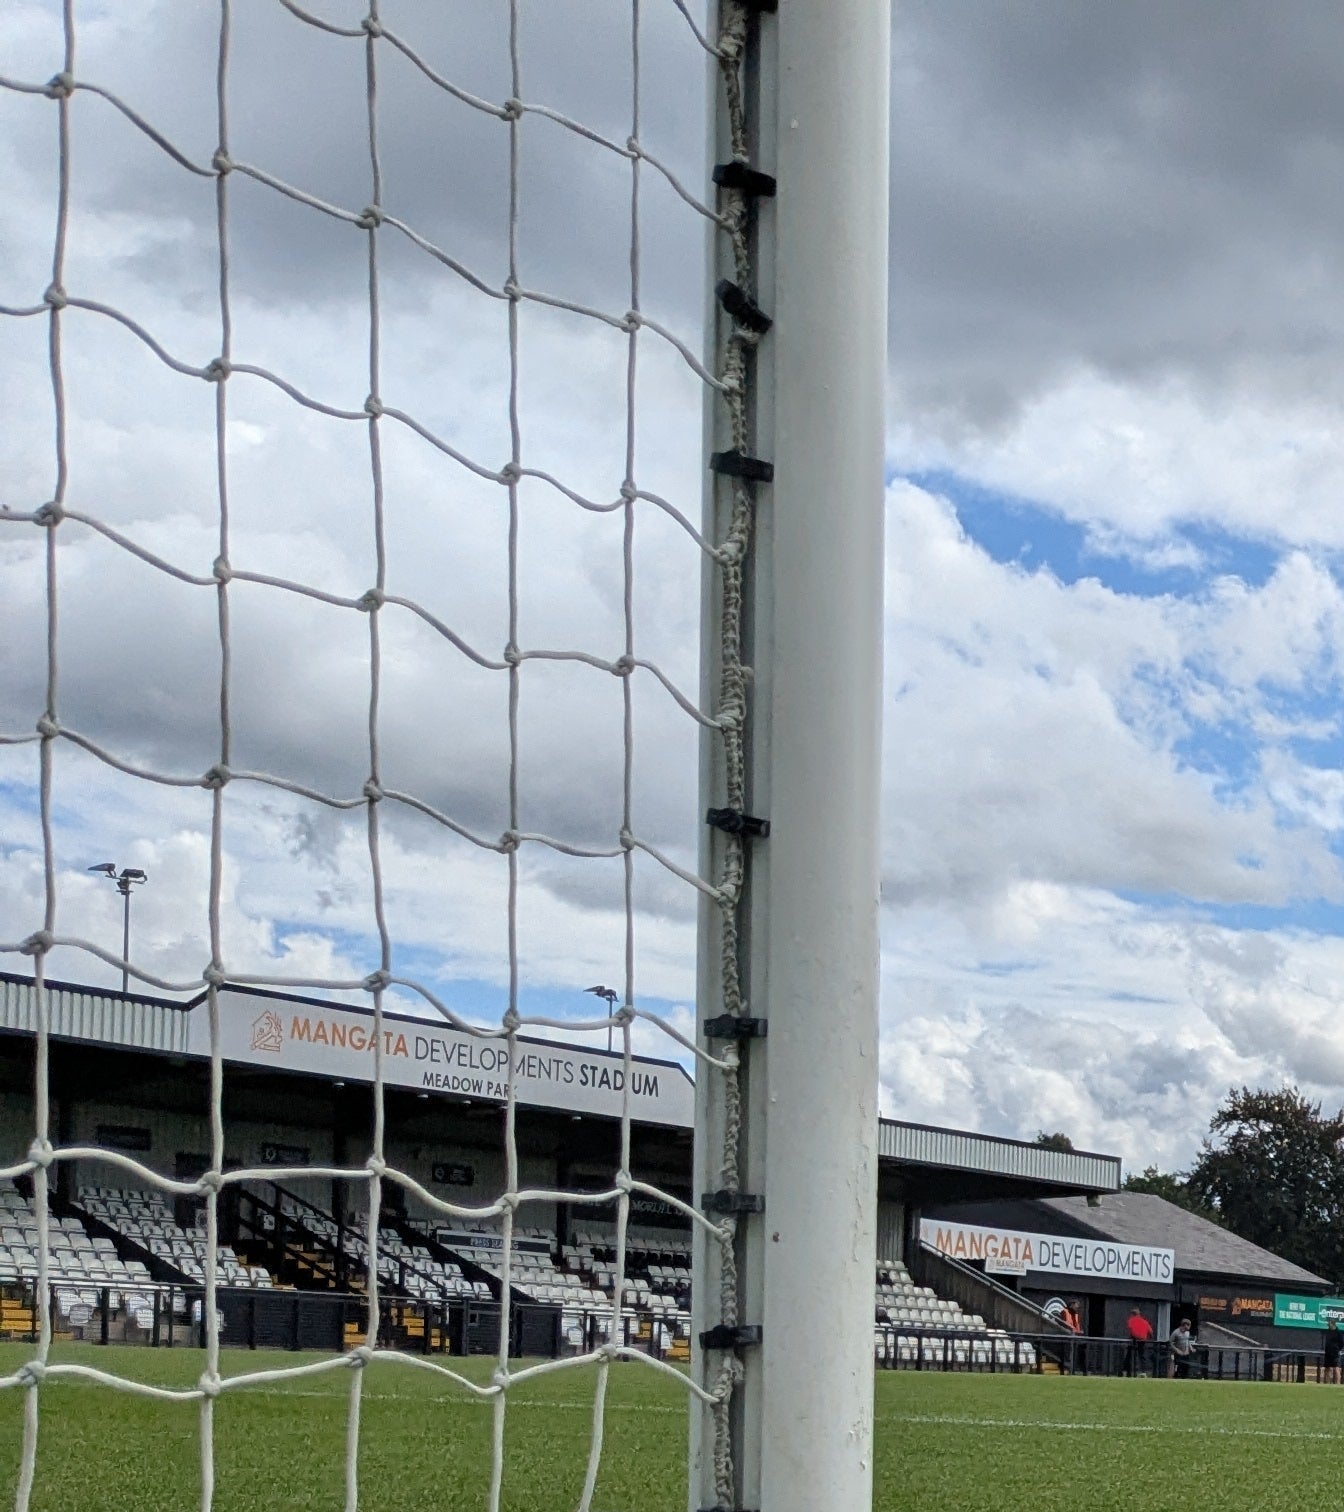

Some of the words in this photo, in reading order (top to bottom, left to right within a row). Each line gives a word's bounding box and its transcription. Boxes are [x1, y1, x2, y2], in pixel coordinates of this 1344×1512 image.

[423, 1072, 483, 1093] MEADOW
[487, 1082, 518, 1099] PAR
[580, 1063, 659, 1098] STADUM
[935, 1228, 1034, 1265] MANGATA
[1039, 1240, 1171, 1279] DEVELOPMENTS
